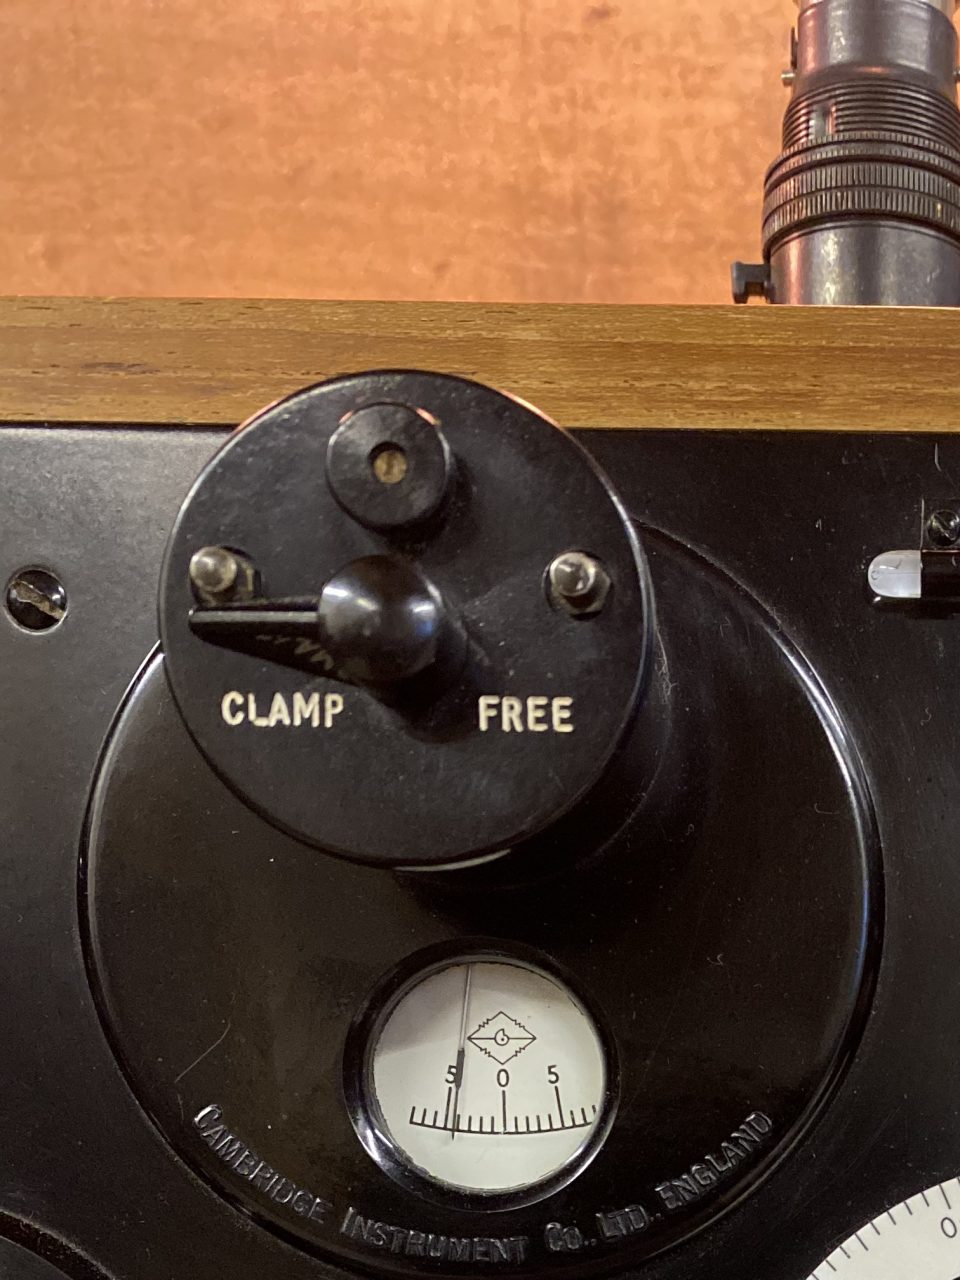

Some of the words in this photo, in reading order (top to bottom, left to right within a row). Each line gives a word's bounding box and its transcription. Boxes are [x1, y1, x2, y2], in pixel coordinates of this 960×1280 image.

[221, 690, 344, 728] CLAMP
[478, 694, 574, 733] FREE
[496, 1068, 510, 1088] 0
[547, 1064, 560, 1085] 5
[654, 1111, 773, 1210] ENGLAND
